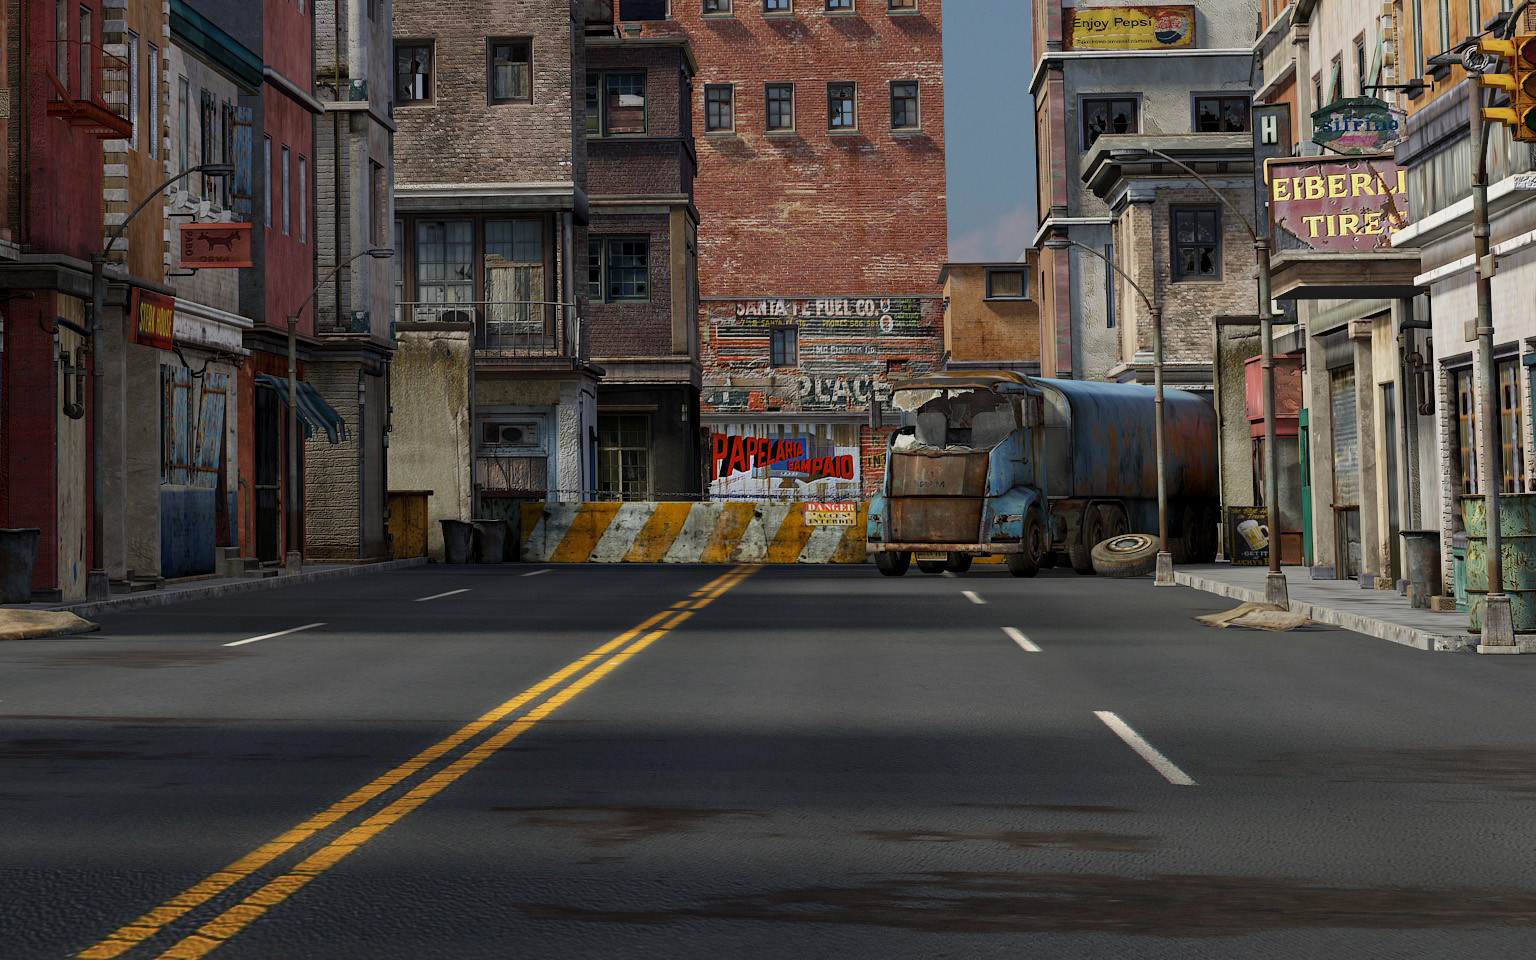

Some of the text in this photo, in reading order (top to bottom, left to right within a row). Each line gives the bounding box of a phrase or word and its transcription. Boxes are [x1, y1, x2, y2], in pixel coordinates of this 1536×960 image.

[1072, 18, 1109, 30] Enjoy
[1114, 16, 1152, 28] Pepsi
[1302, 211, 1408, 238] TIRES
[736, 299, 788, 316] SANTA
[815, 299, 853, 317] FUEL
[855, 299, 880, 317] CO.
[798, 374, 890, 402] PLACE
[712, 433, 804, 480] PAPELARIA
[787, 454, 854, 480] SAMPAIO
[807, 503, 855, 511] DANGER
